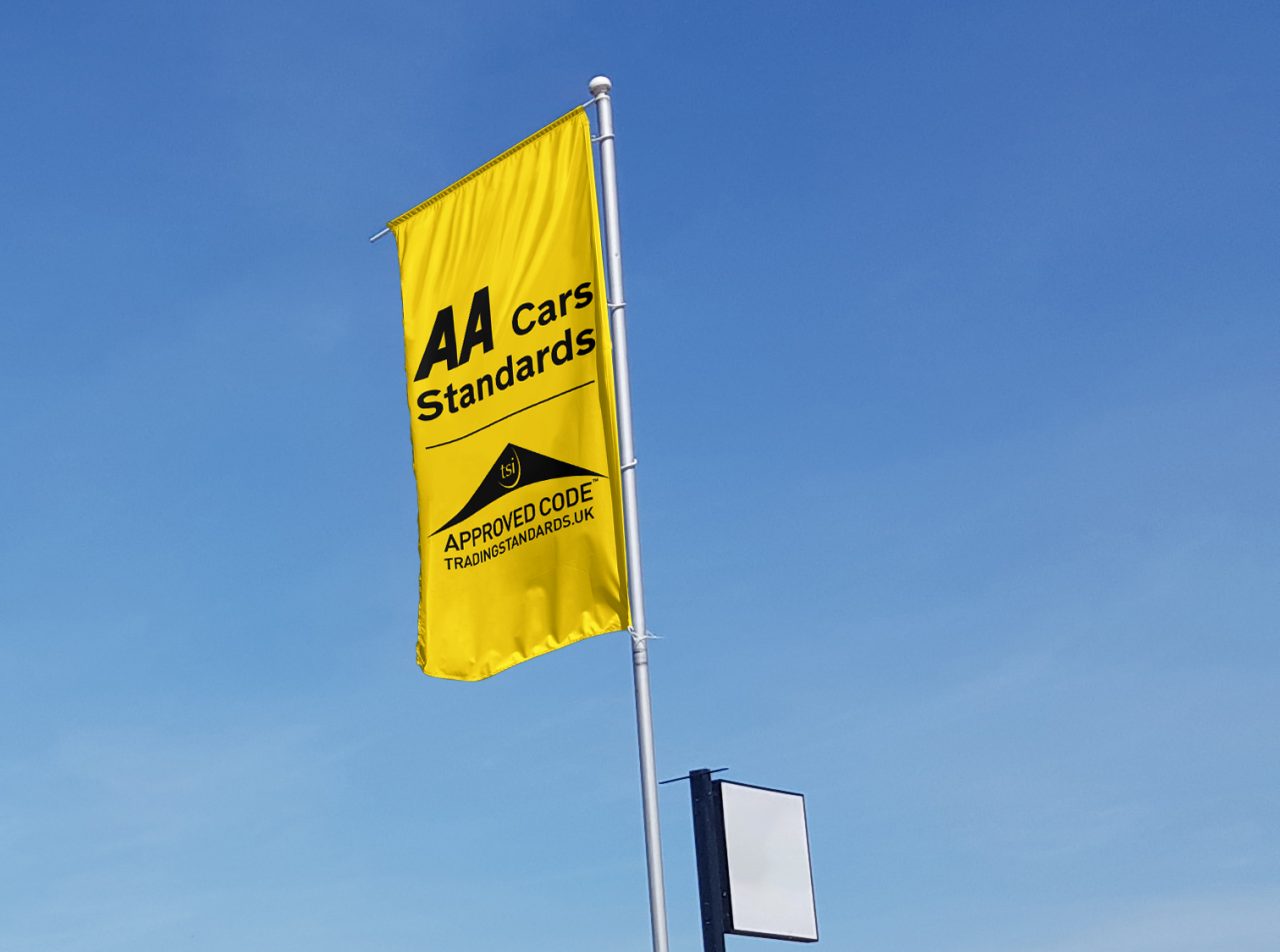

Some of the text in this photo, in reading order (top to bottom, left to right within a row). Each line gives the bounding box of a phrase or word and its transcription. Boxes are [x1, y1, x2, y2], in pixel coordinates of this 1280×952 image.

[413, 281, 594, 382] AA Cars
[417, 328, 596, 421] Standards
[500, 457, 516, 479] tsi
[444, 503, 536, 552] APPROVED
[540, 482, 593, 516] CODE
[444, 507, 595, 570] TRADINGSTANDARDS.UK
